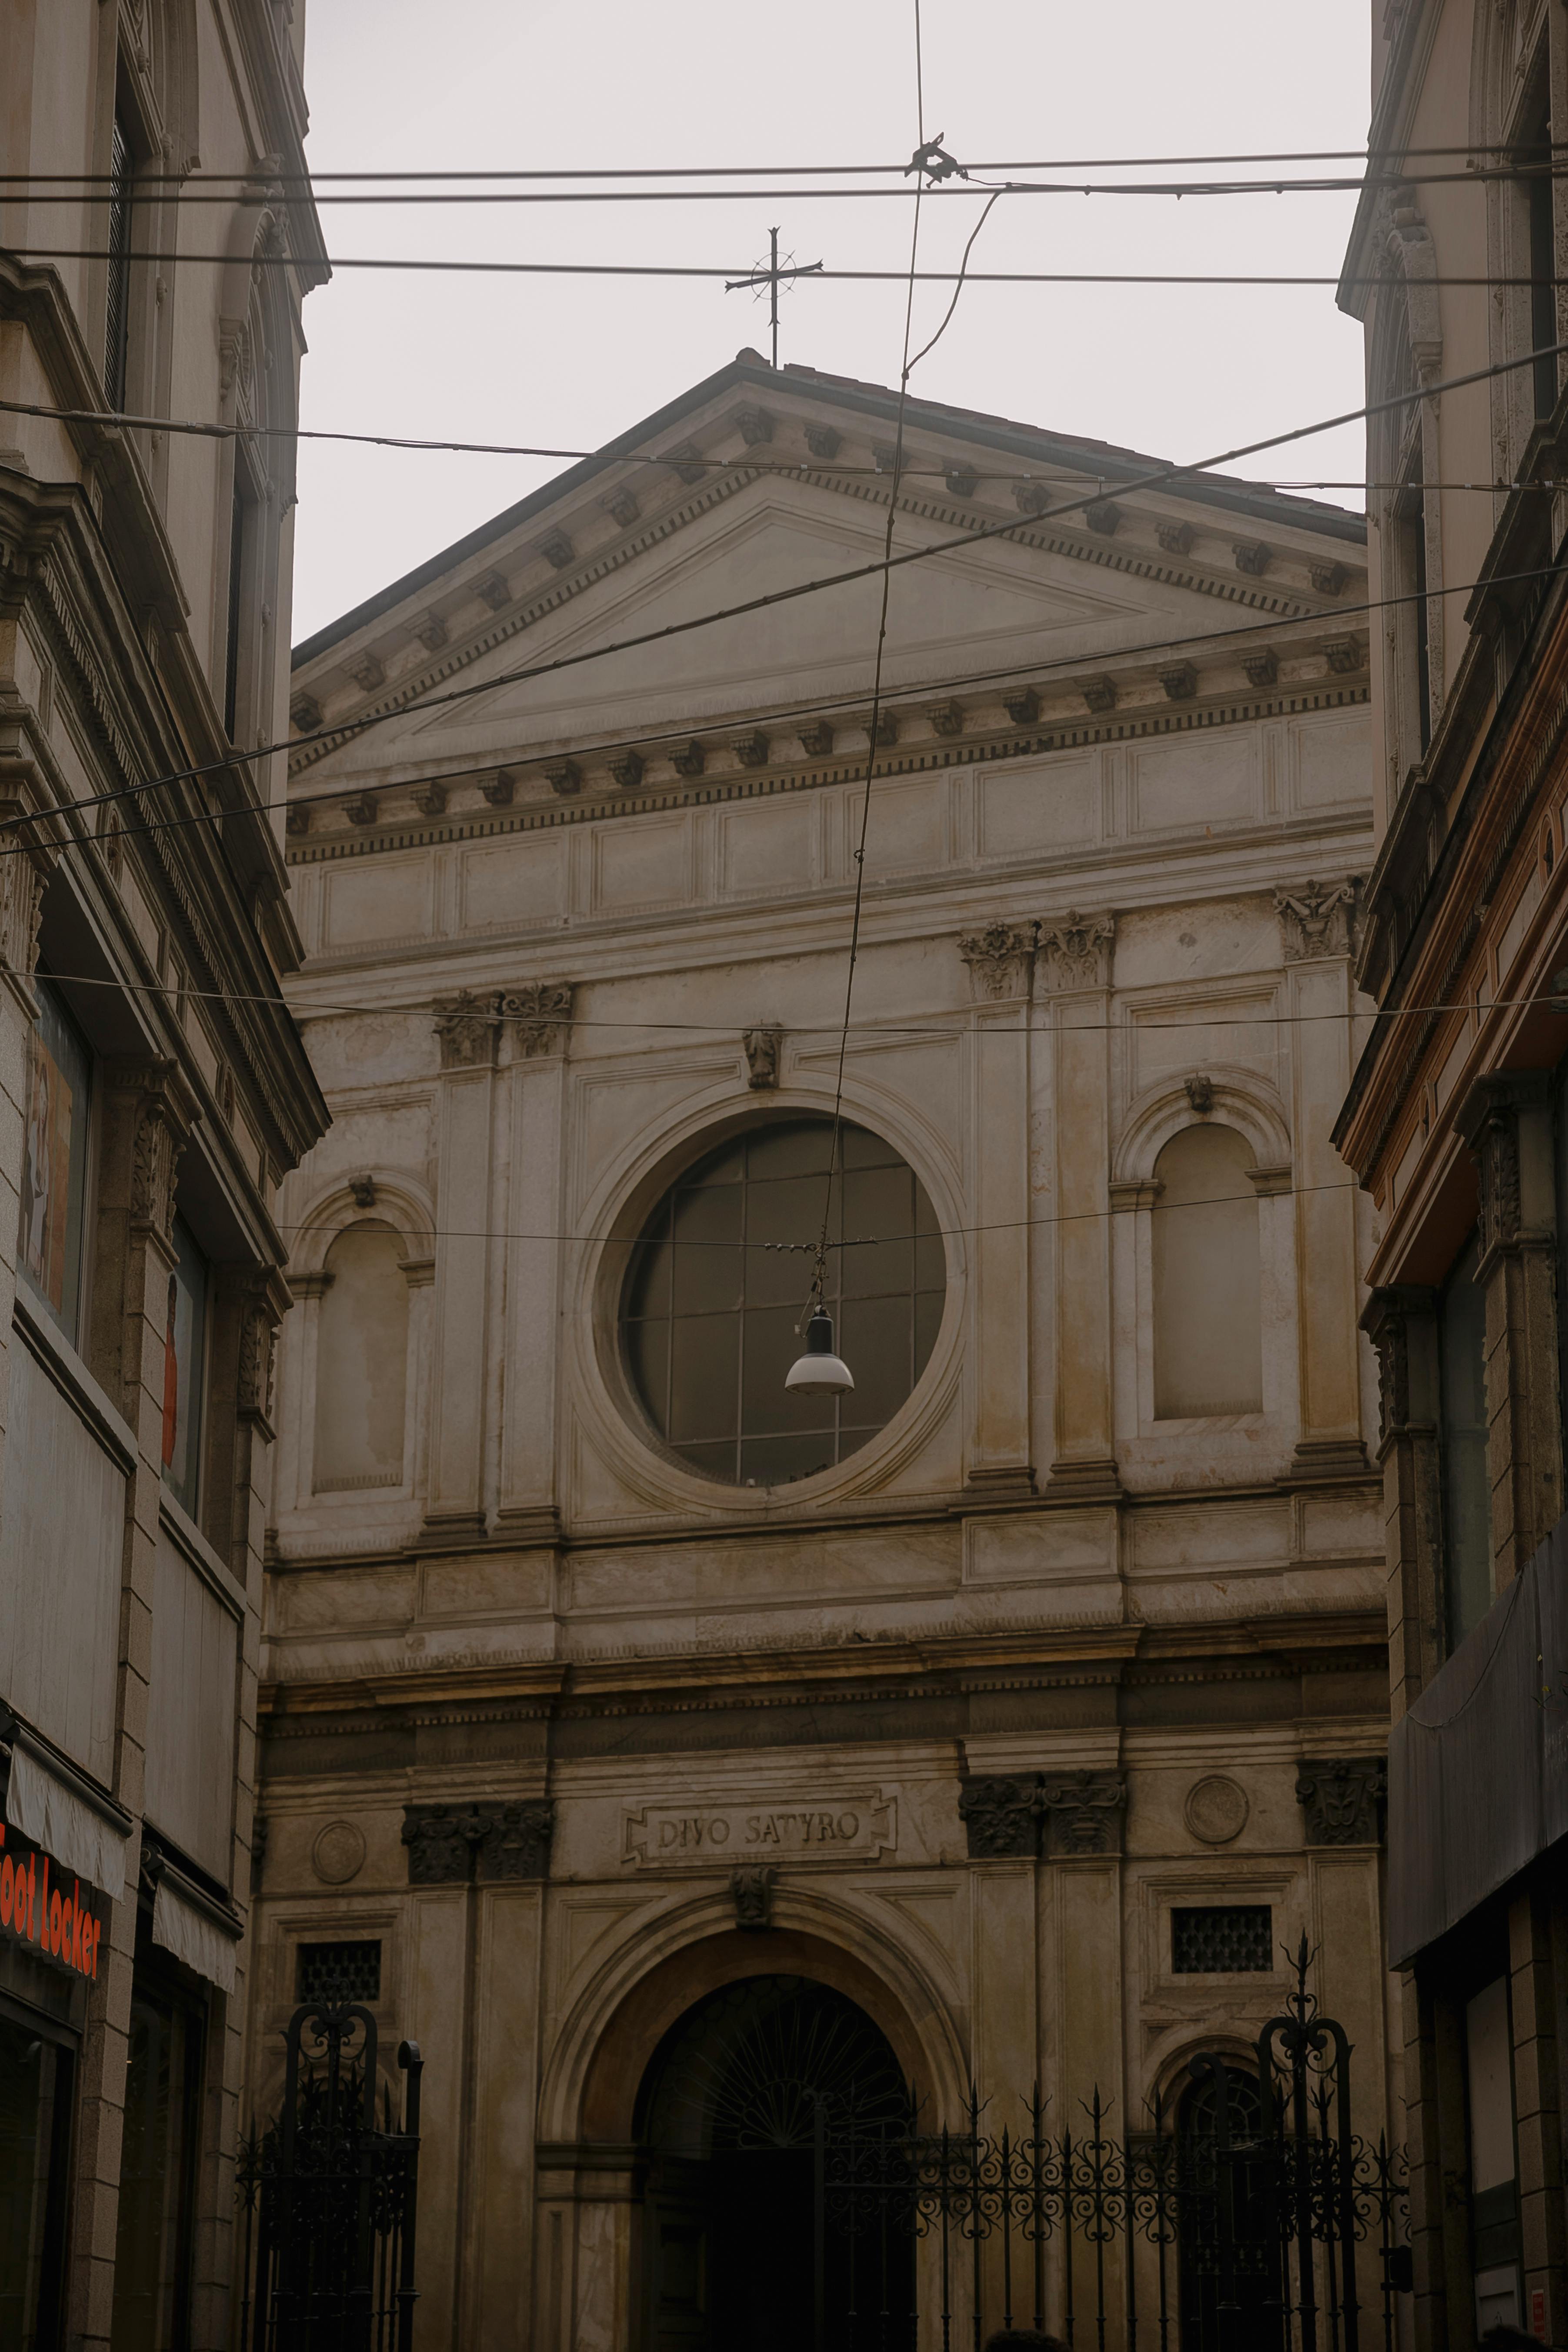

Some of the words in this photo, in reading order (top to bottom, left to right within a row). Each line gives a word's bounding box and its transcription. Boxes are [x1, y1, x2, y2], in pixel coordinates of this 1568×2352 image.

[658, 1818, 730, 1848] DIVO
[744, 1812, 859, 1844] SATYRO
[0, 1823, 36, 1942] oot
[40, 1855, 101, 1980] Locker
